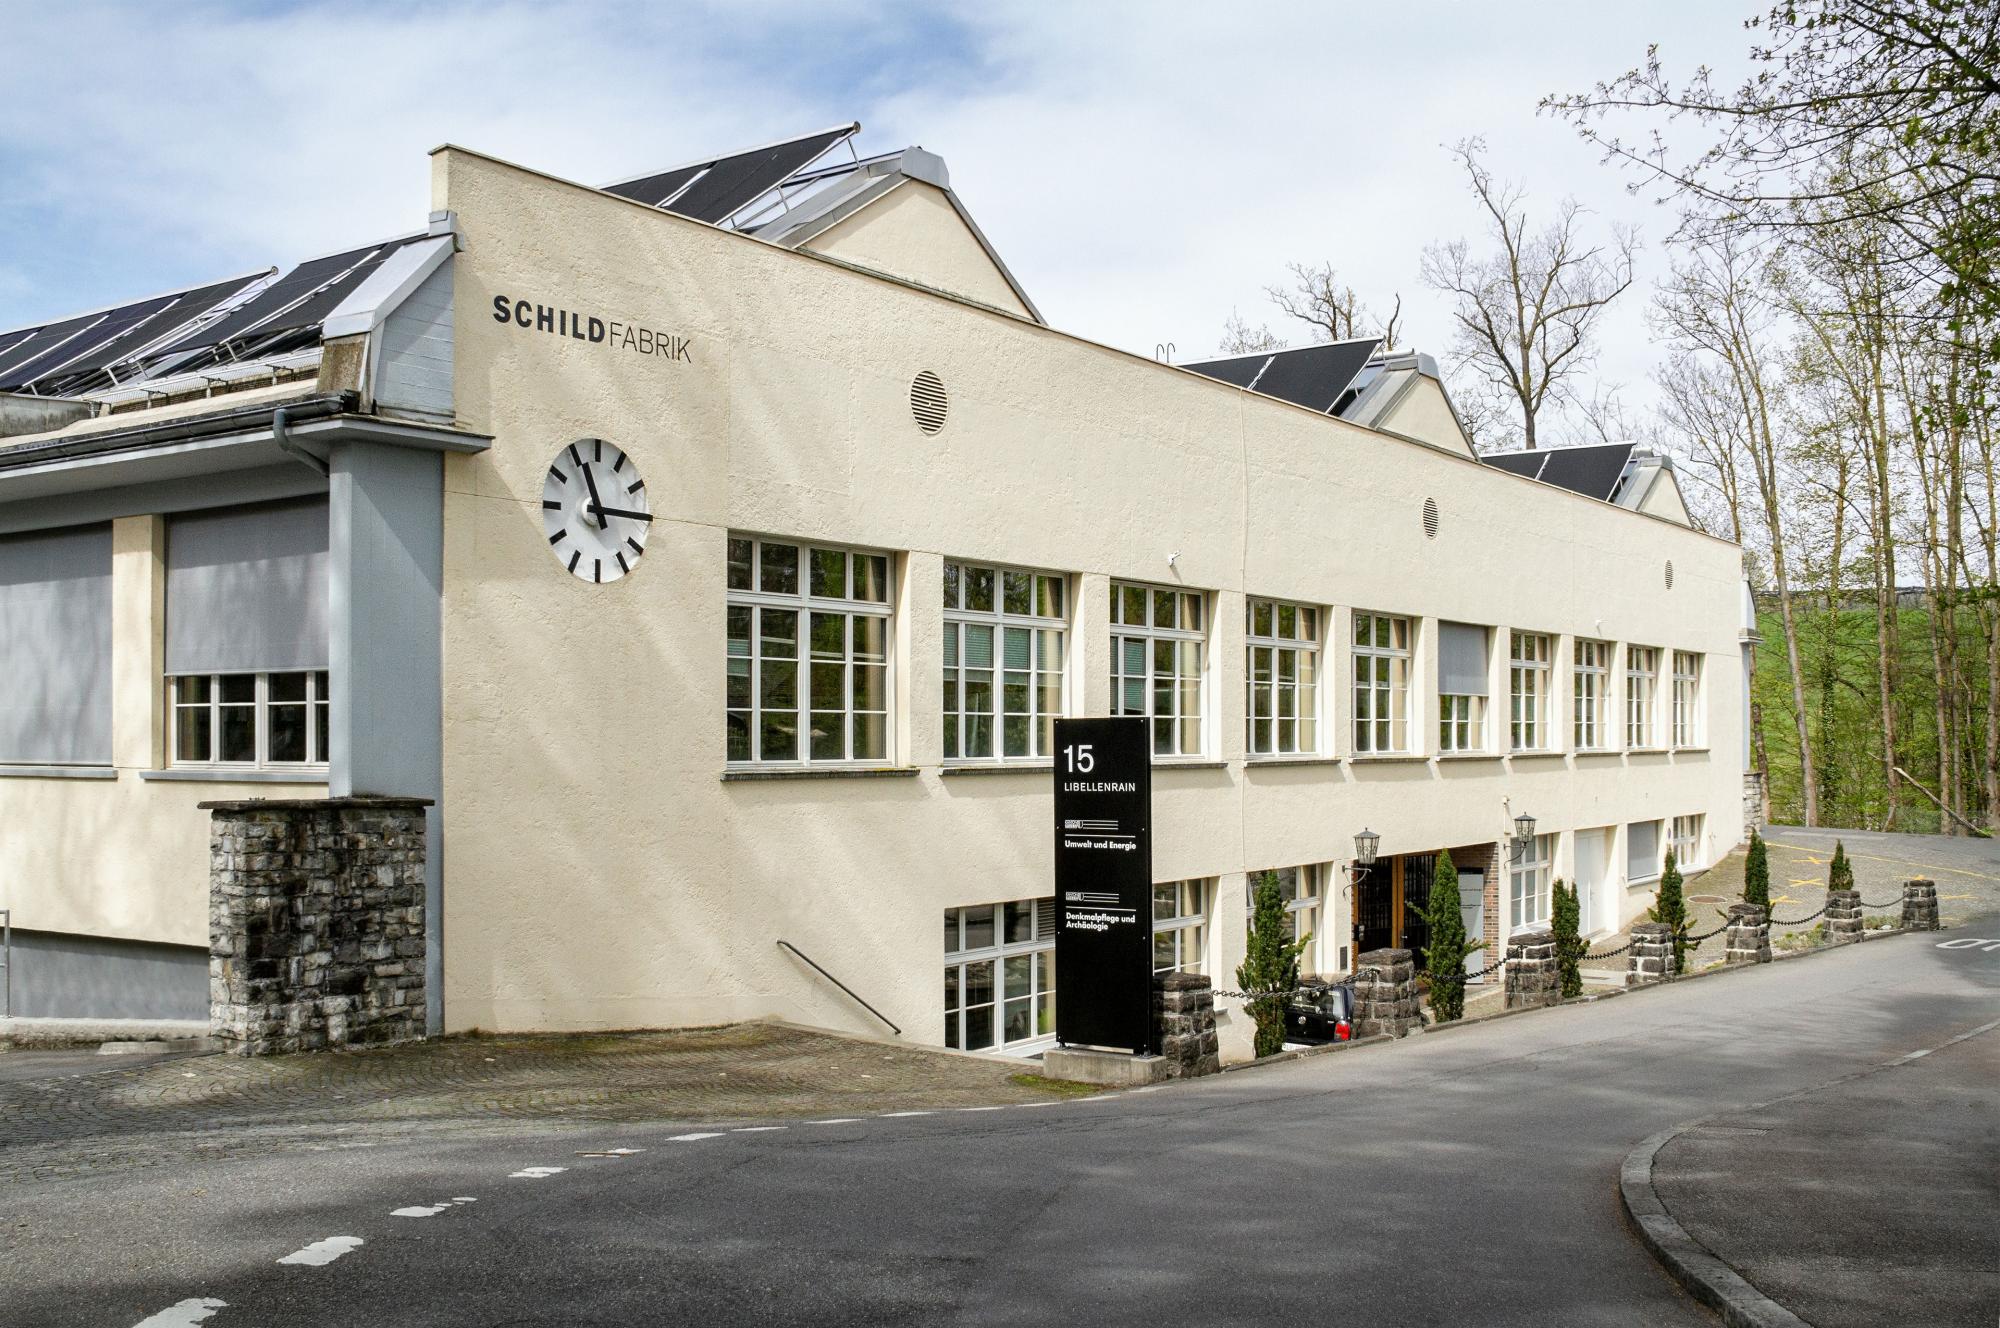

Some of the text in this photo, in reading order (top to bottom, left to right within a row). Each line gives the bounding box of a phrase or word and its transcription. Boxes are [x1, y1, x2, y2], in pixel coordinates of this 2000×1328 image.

[493, 295, 691, 363] SCHILDFABRIK
[1063, 744, 1094, 773] 15
[1064, 782, 1136, 792] LIBELLENRAIN
[1065, 840, 1136, 851] Umwelt und Energie
[1066, 912, 1136, 923] Denkmalpflege und
[1066, 920, 1108, 931] Archäologie
